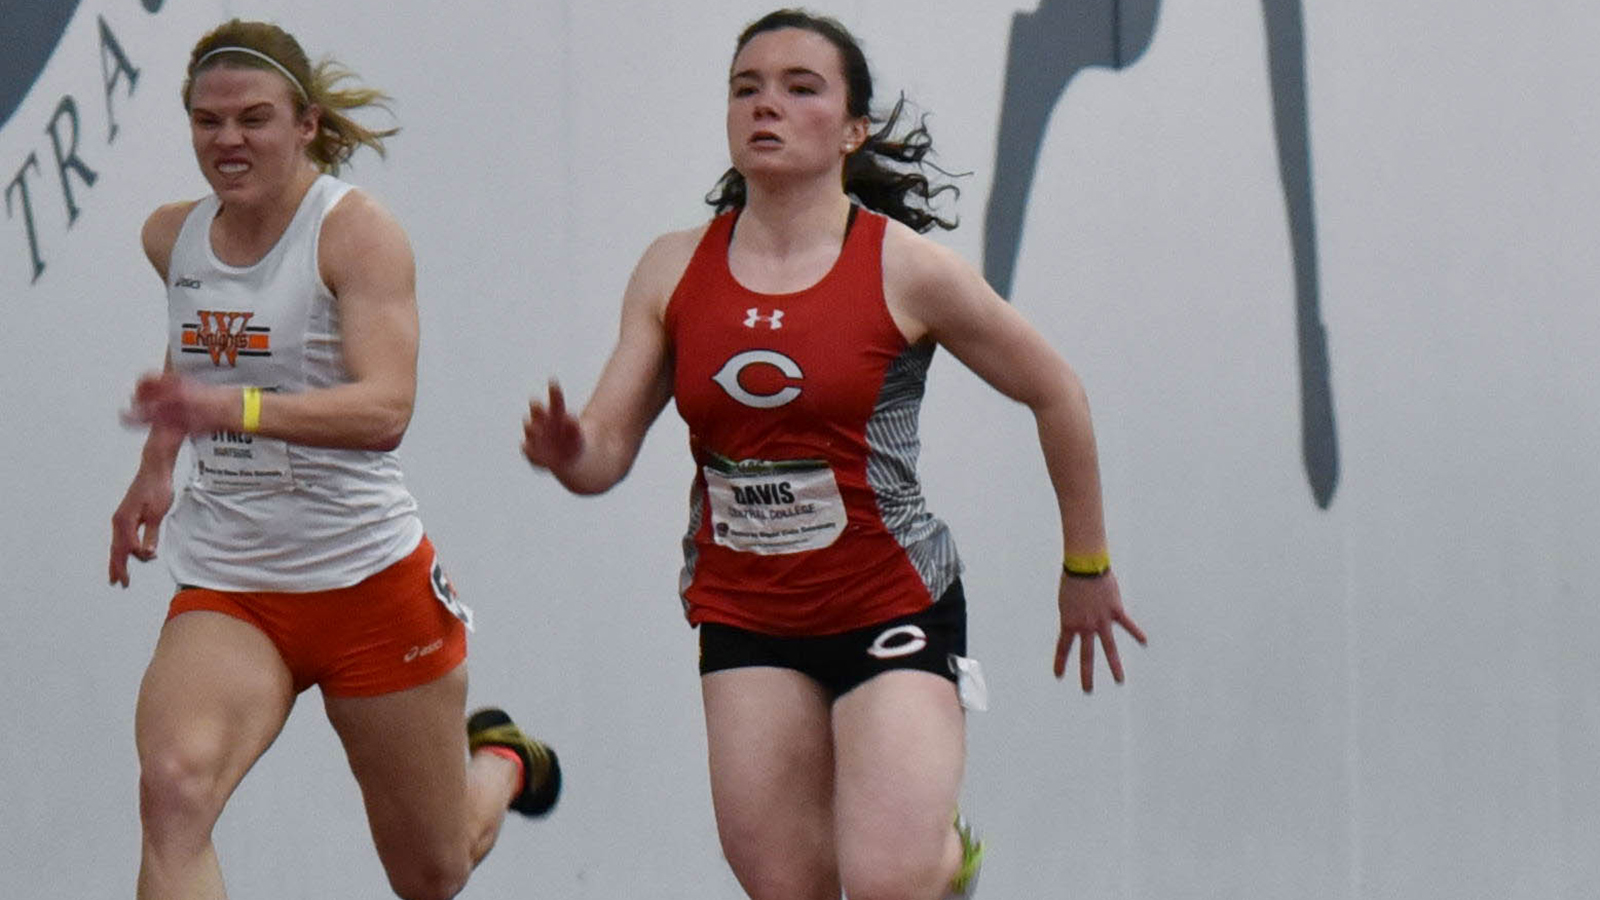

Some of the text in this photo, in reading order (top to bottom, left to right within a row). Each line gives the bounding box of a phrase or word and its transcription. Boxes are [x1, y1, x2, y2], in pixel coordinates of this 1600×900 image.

[5, 0, 165, 285] TRA
[731, 481, 796, 505] DAVIS
[769, 503, 816, 520] COLLEGE
